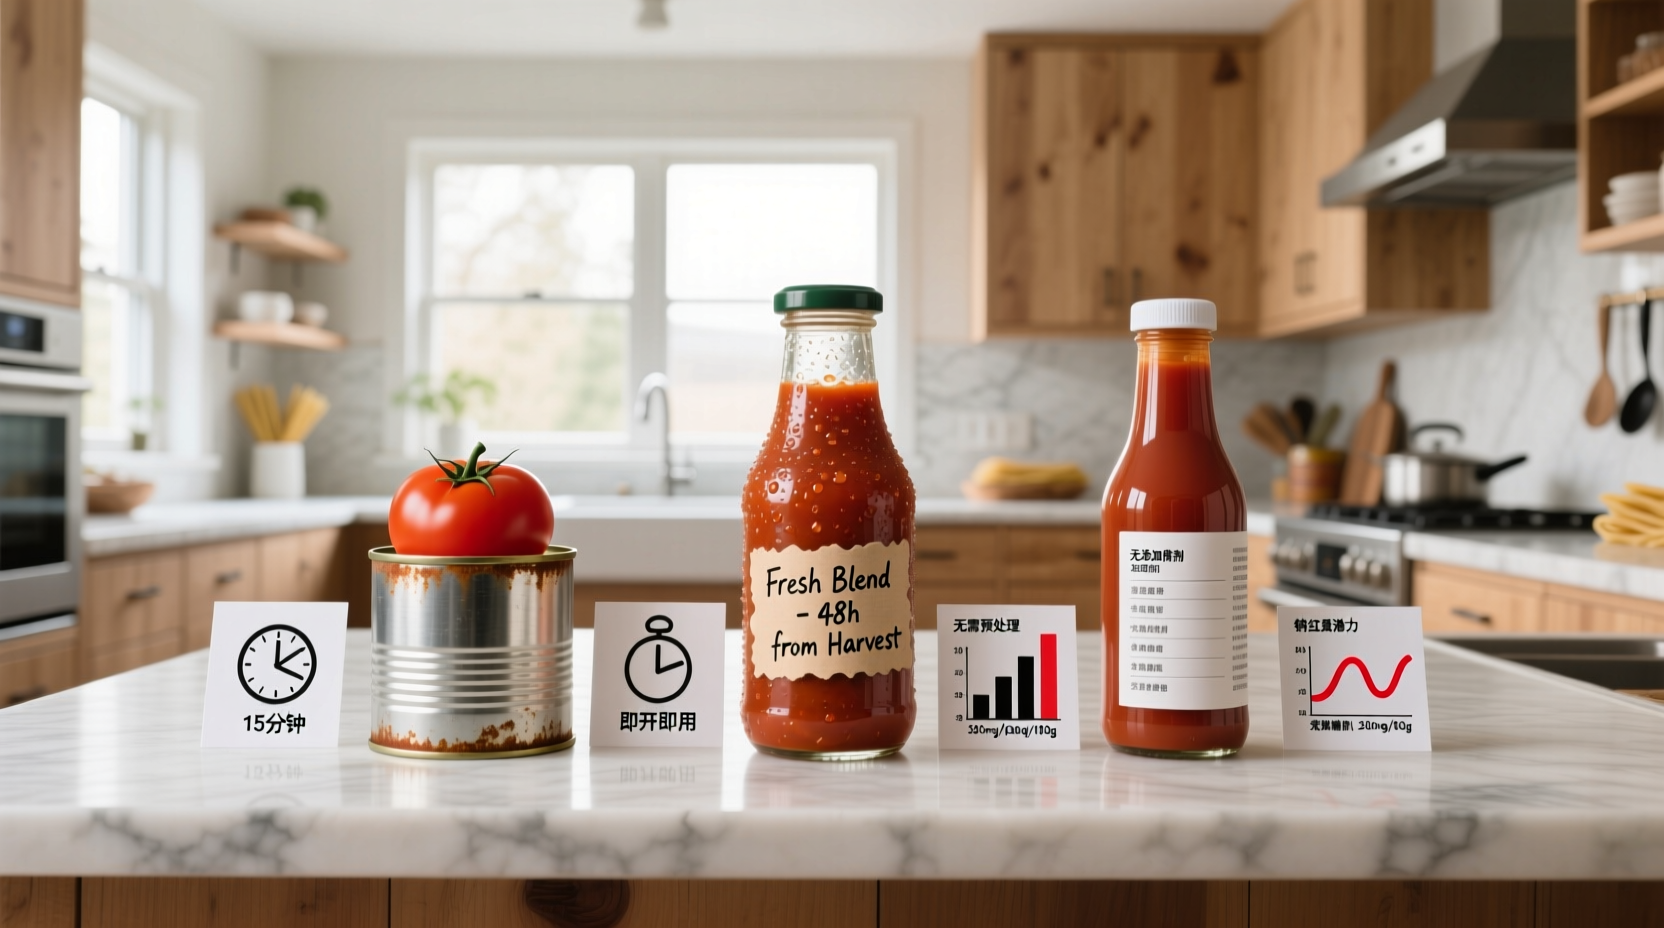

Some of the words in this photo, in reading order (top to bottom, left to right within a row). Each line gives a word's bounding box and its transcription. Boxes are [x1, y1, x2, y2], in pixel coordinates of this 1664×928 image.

[767, 567, 821, 597] Fresh
[833, 560, 890, 593] Blend
[818, 600, 859, 626] 48h
[953, 617, 1020, 633] 无需预处理
[772, 630, 817, 662] from
[828, 626, 902, 656] Harvest
[243, 713, 306, 734] 15分钟
[620, 711, 696, 732] 即开即用
